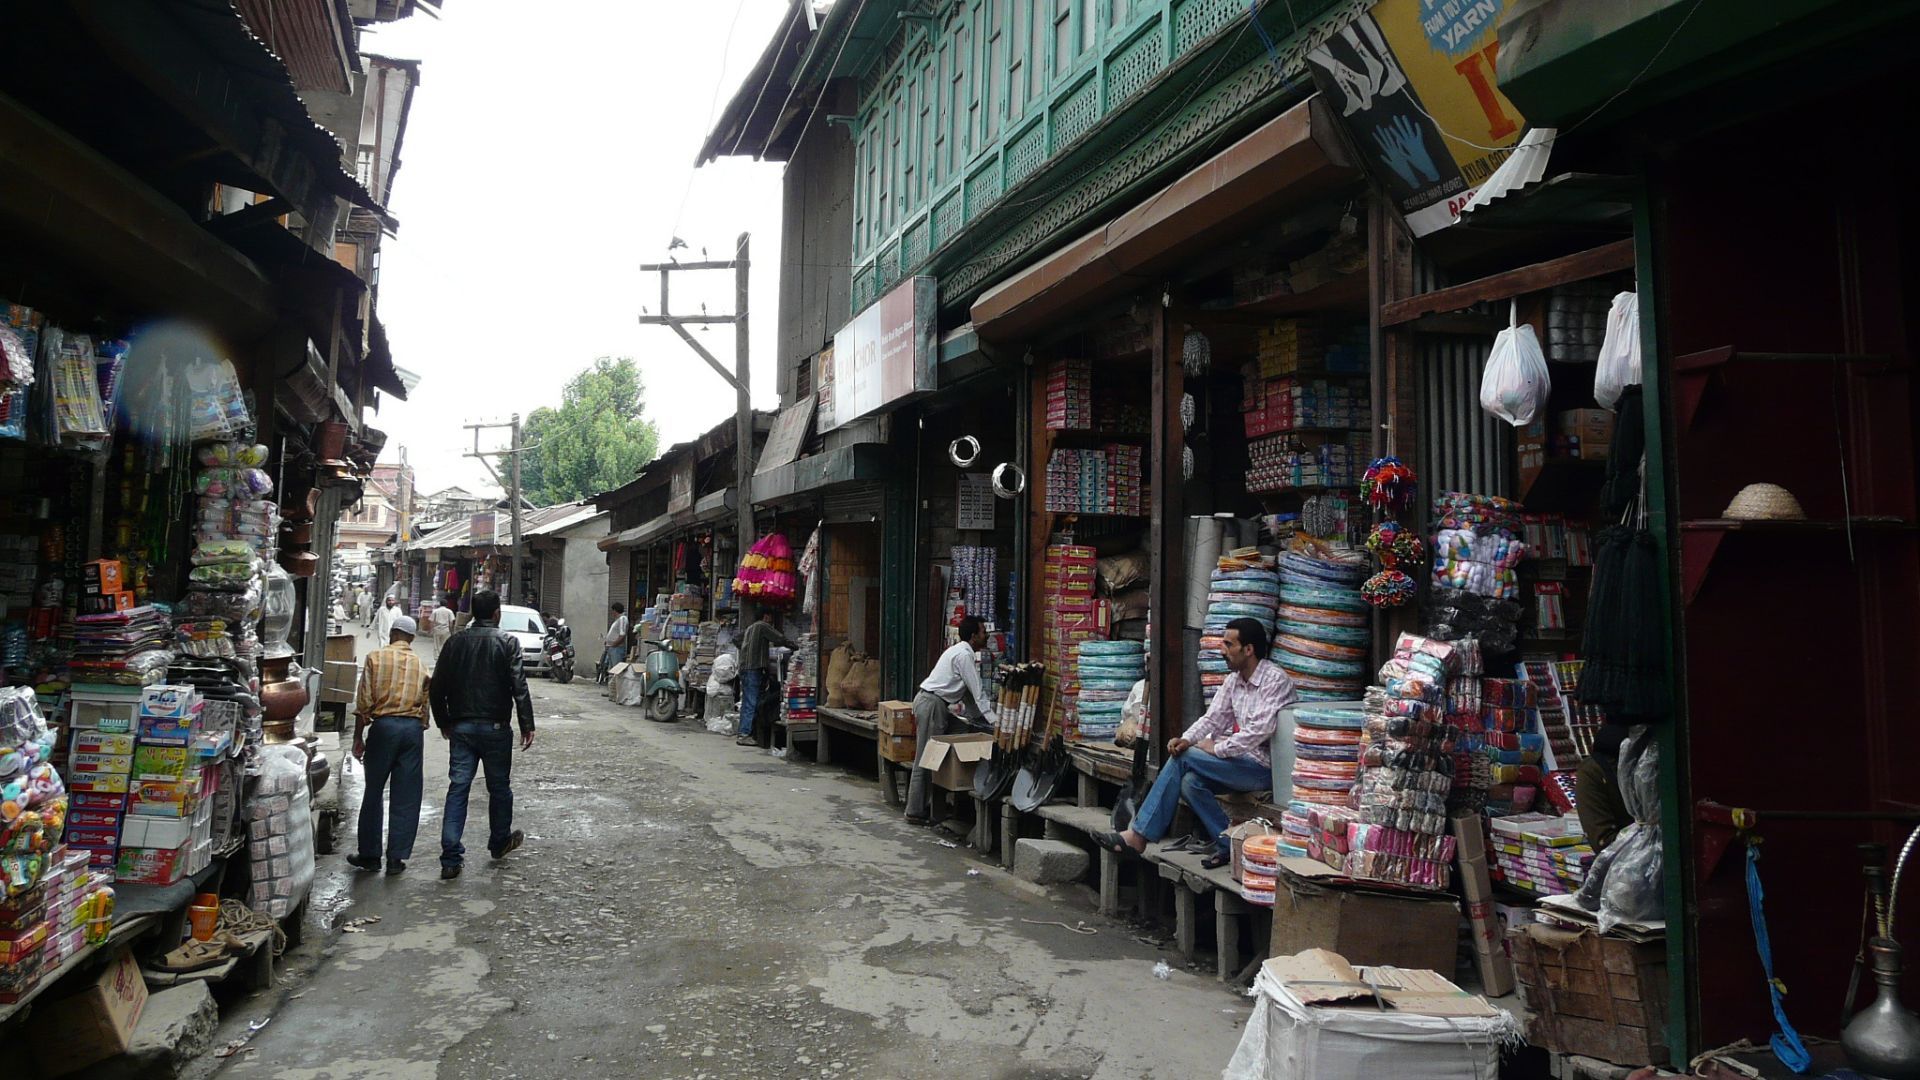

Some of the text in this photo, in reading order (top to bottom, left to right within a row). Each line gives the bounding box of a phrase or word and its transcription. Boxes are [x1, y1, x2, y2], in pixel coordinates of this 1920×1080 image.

[1441, 0, 1496, 49] YARN
[1454, 40, 1518, 142] I
[846, 340, 877, 379] ANCHOR
[148, 694, 177, 703] Plus
